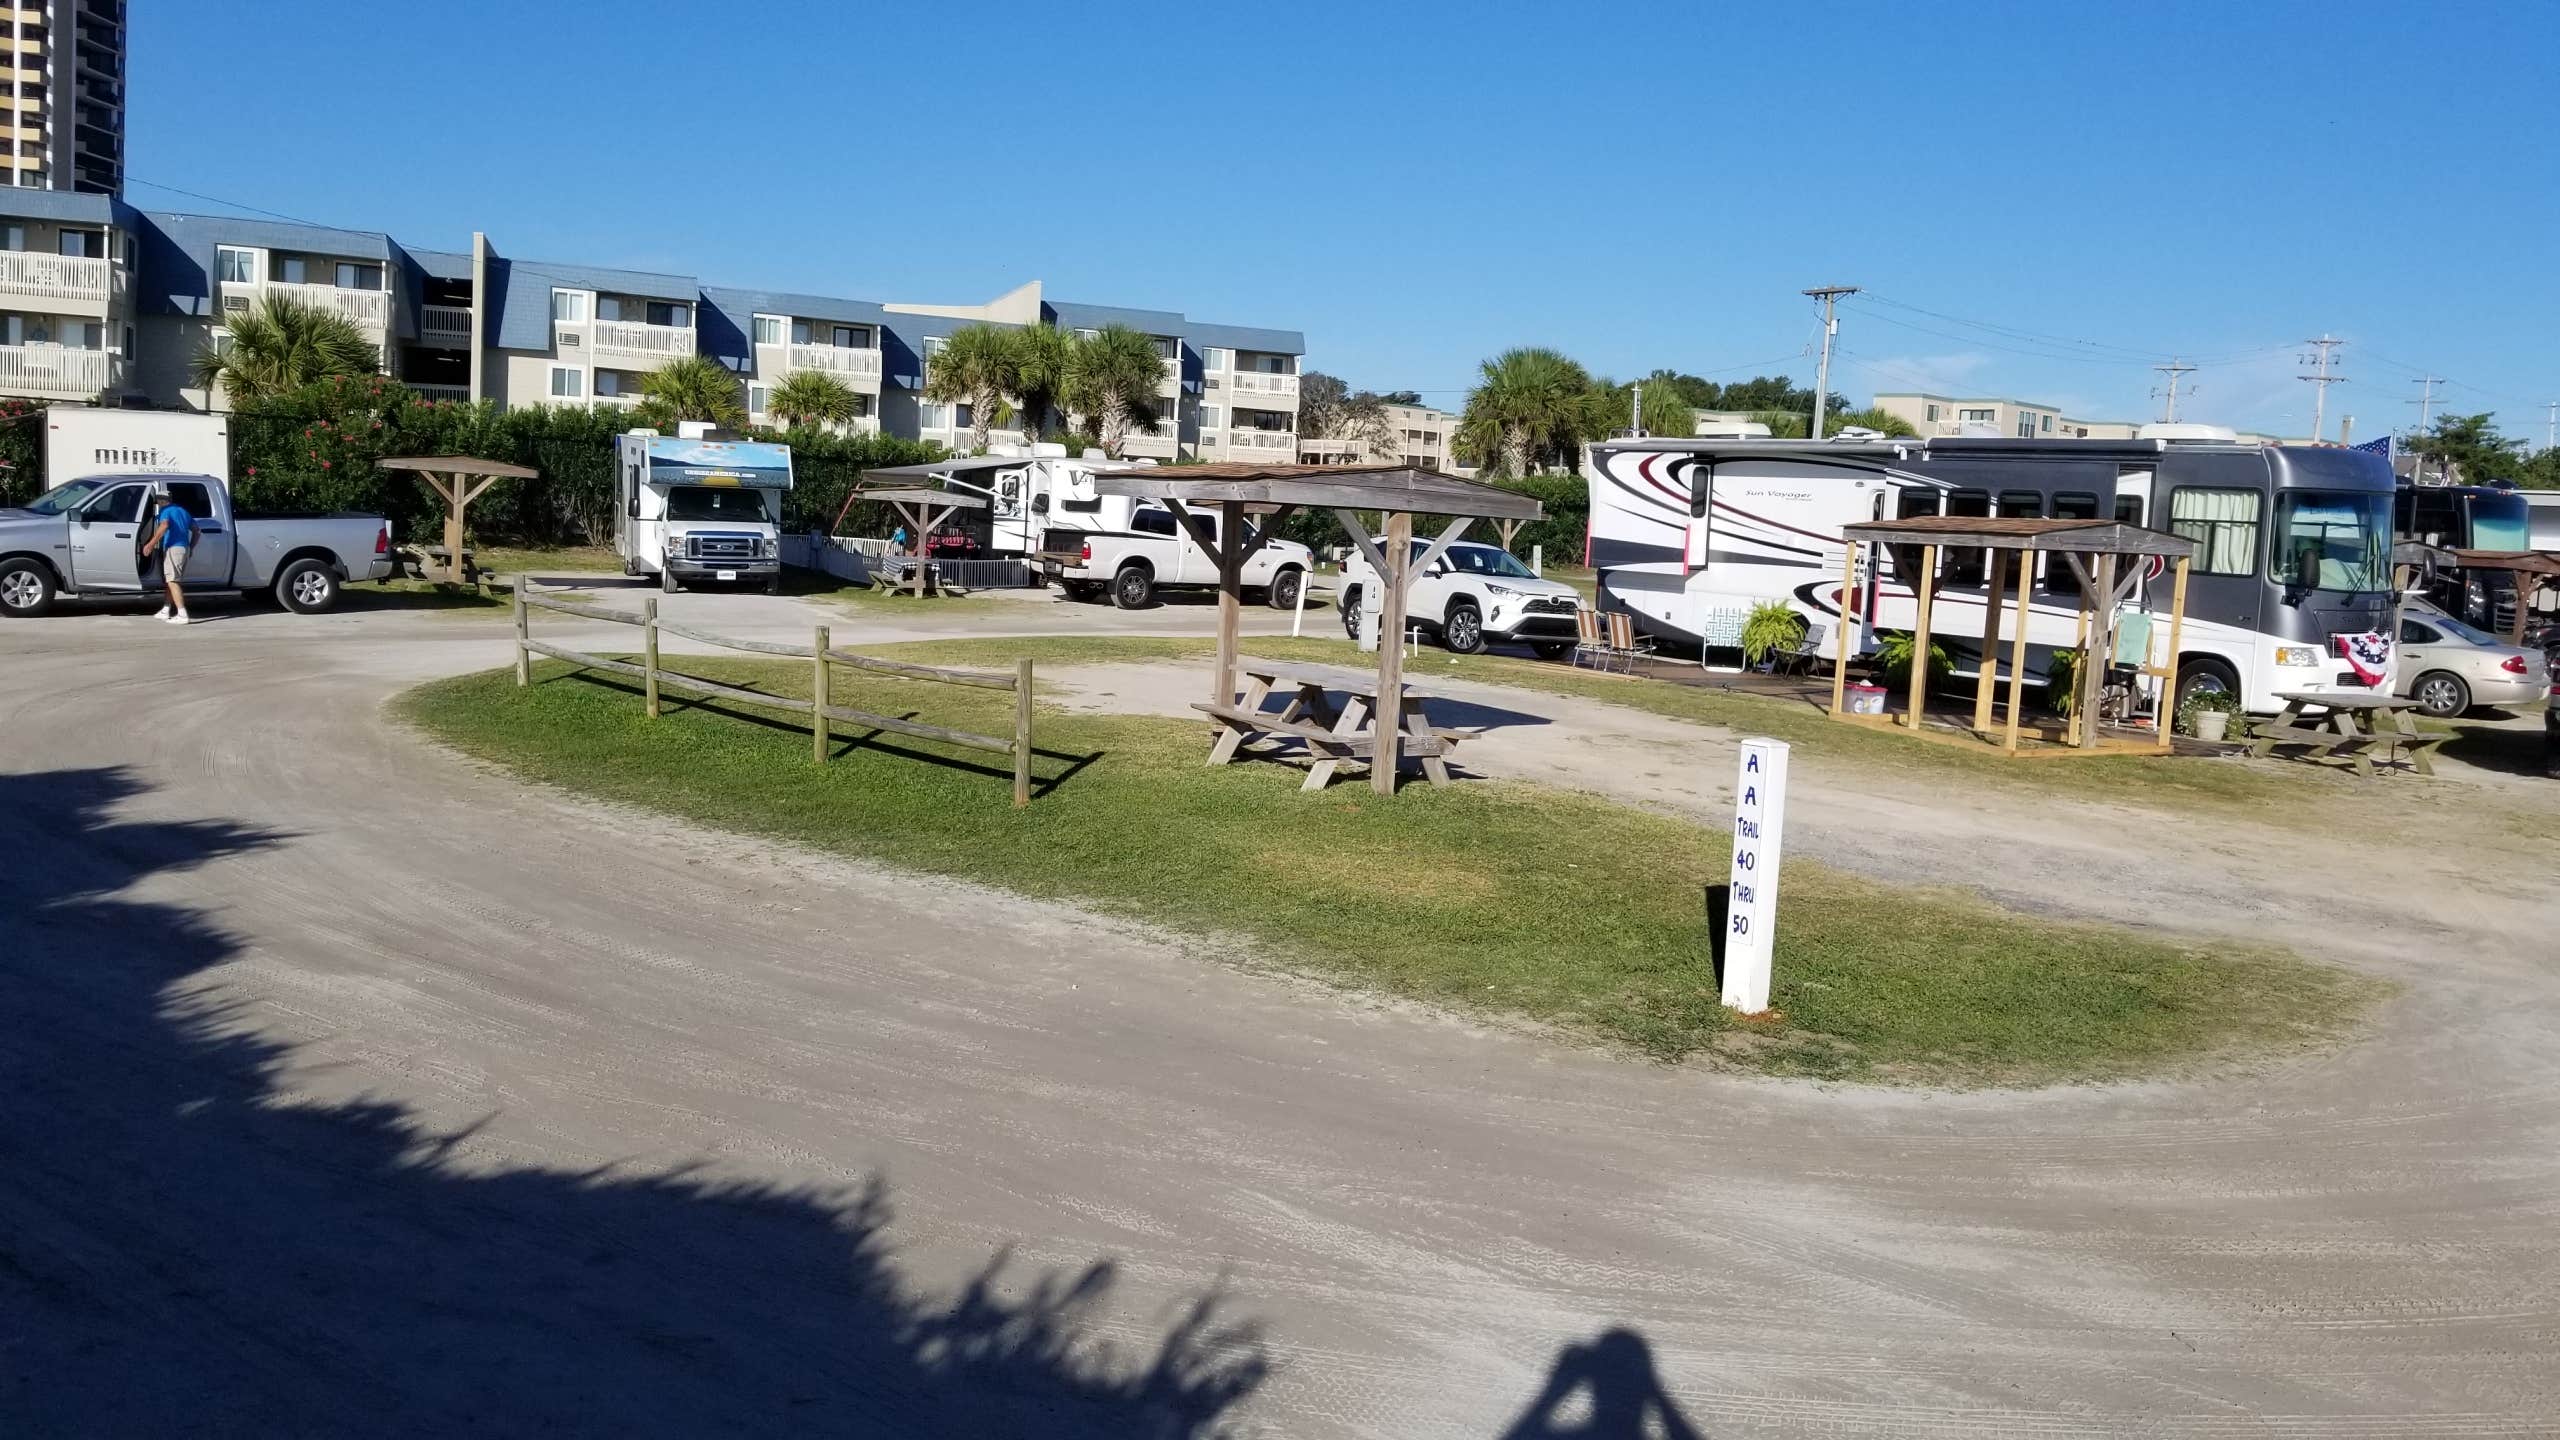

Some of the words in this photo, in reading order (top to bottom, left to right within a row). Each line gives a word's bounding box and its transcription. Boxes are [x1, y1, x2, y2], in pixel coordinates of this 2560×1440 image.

[95, 446, 157, 465] mini
[1747, 753, 1759, 774] A
[1744, 785, 1757, 806] A
[1737, 816, 1759, 839] TRAIL
[1736, 849, 1755, 871] 40
[1733, 881, 1755, 904] THRU
[1733, 914, 1749, 935] 50
